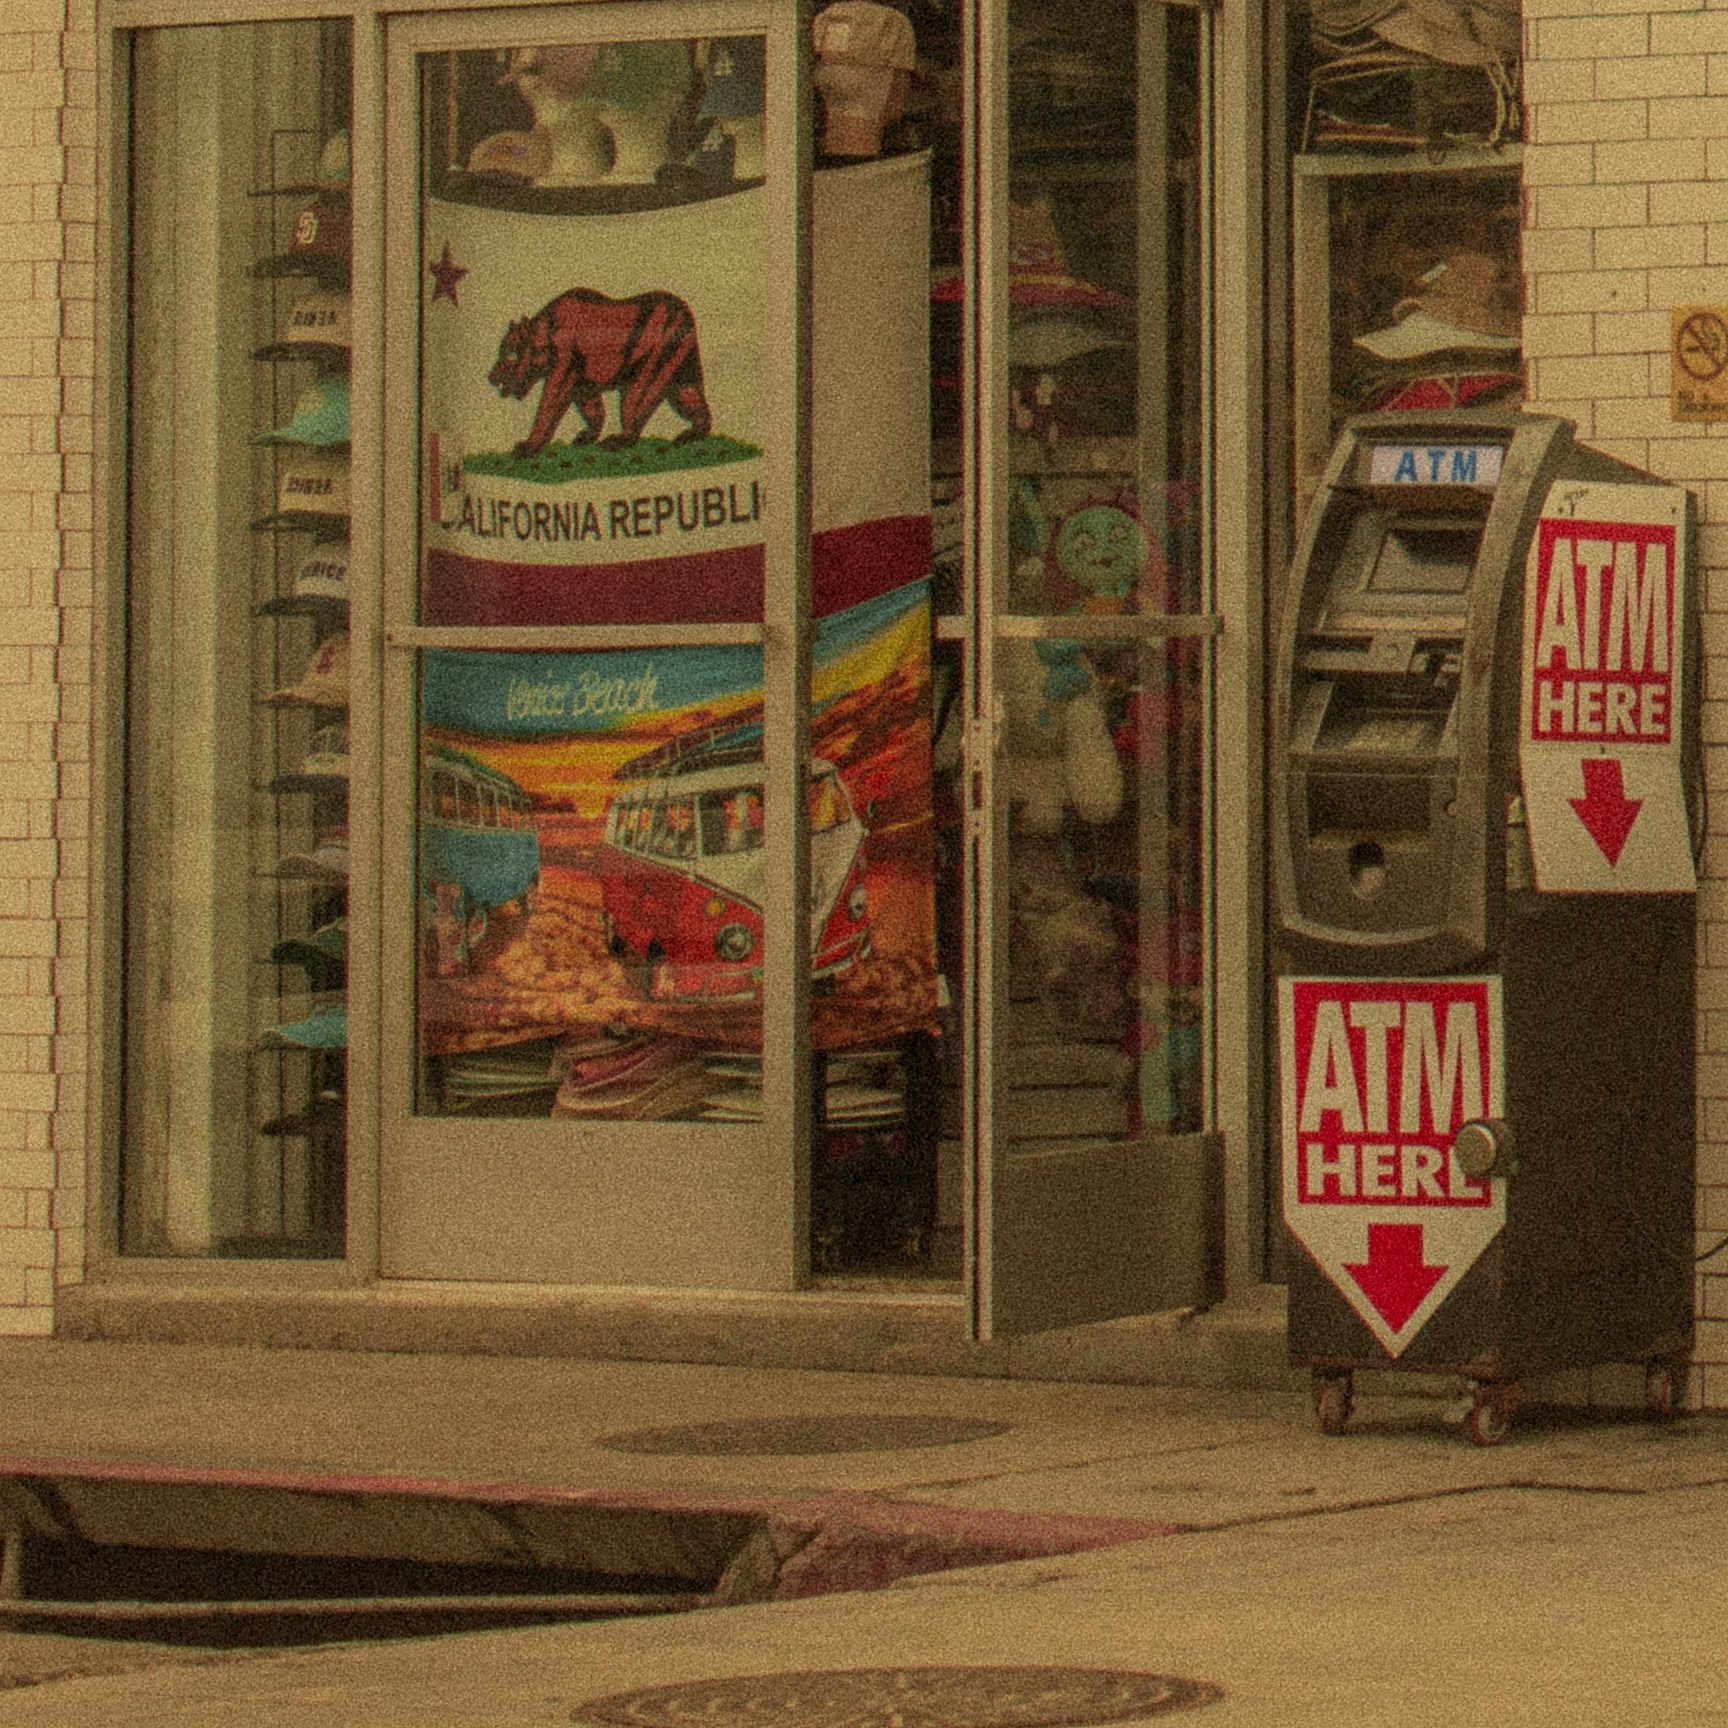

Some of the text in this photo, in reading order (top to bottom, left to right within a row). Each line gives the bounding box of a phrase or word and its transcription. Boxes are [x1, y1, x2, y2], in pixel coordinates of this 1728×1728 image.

[1394, 446, 1479, 483] ATM
[609, 479, 767, 540] REPUBLI
[1537, 536, 1668, 674] ATM
[1538, 679, 1669, 737] HERE
[1299, 1000, 1489, 1135] ATM
